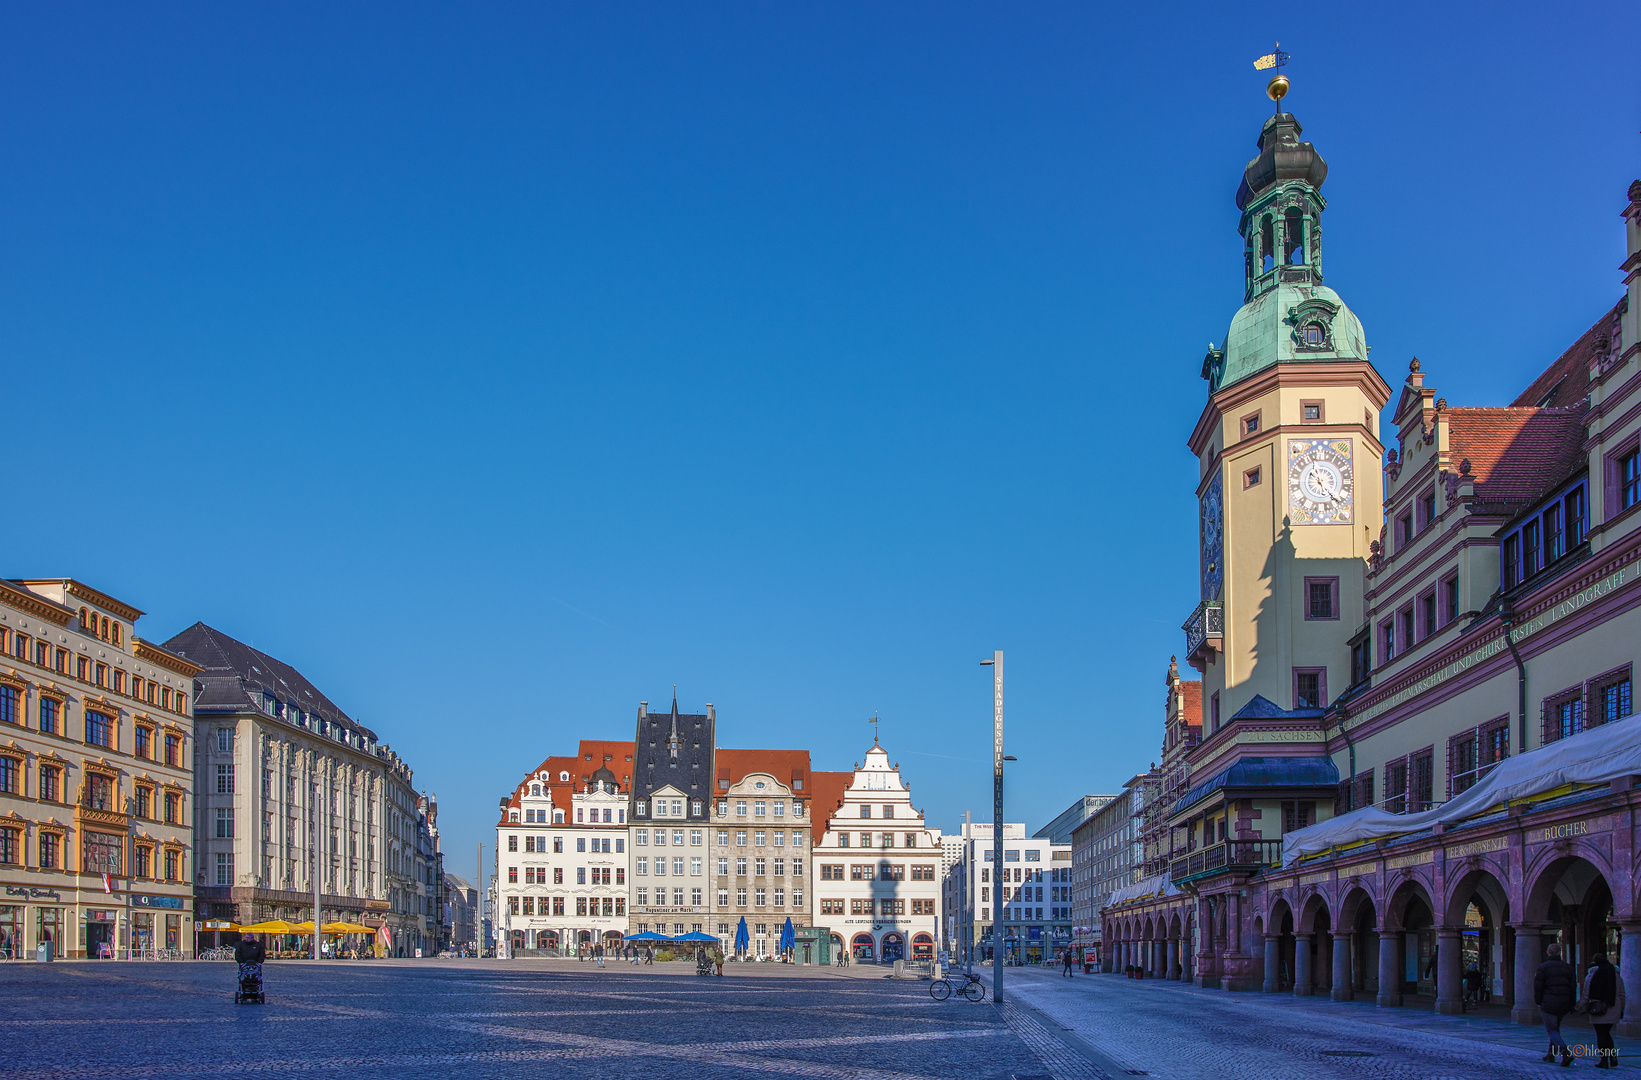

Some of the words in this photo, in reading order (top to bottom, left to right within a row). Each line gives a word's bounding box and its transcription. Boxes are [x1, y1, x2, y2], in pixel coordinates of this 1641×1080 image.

[1453, 656, 1472, 673] UND
[1475, 615, 1545, 662] CHURFRSTEN
[1552, 568, 1626, 621] LANDGRAFF
[1247, 732, 1264, 741] ZU
[1271, 731, 1322, 741] SACHSEN
[1544, 821, 1587, 840] BÜCHER
[1446, 847, 1459, 858] TEE
